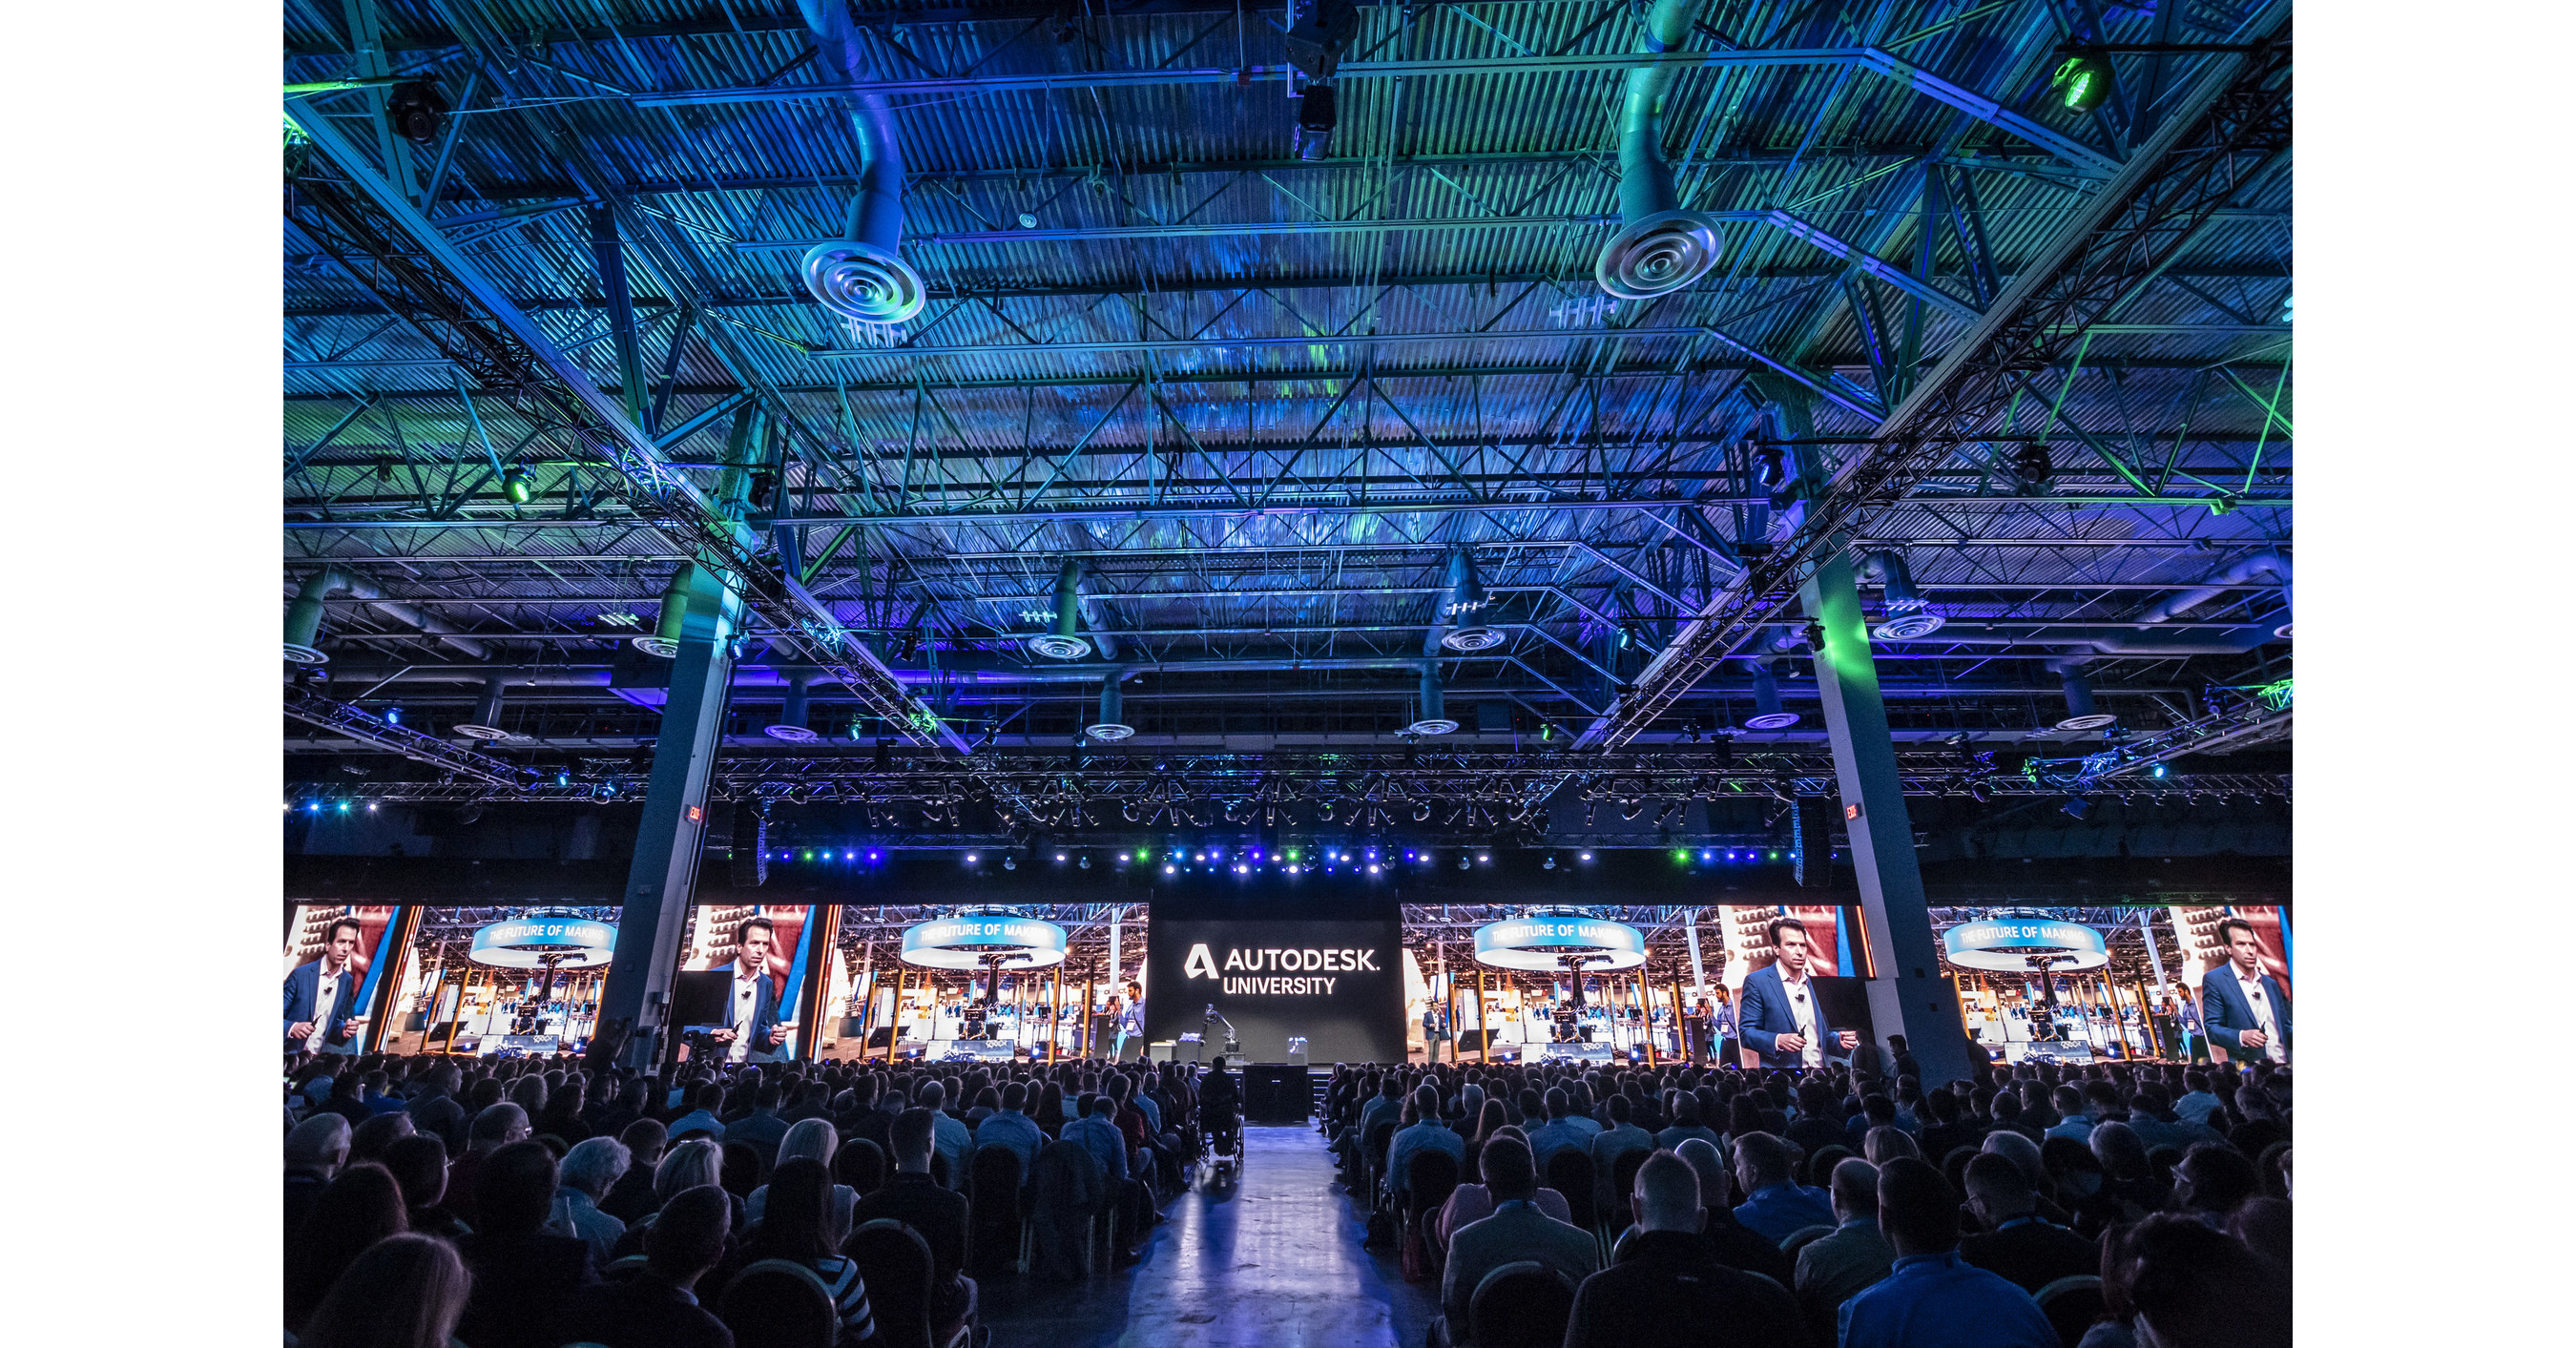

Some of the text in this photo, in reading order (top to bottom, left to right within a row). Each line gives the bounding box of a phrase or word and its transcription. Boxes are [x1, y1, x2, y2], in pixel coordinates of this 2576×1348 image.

[505, 924, 545, 939] FUTURE
[547, 924, 564, 937] OF
[565, 925, 605, 941] MAKING
[937, 923, 982, 939] FUTURE
[984, 923, 1002, 936] OF
[1004, 924, 1049, 939] MAK
[1509, 924, 1555, 939] FUTURE
[1557, 924, 1575, 937] OF
[1578, 925, 1625, 941] MAK
[1977, 926, 2020, 942] FUTURE
[2022, 926, 2038, 938] OF
[2042, 927, 2087, 943] MAKING
[1224, 948, 1381, 971] AUTODESK.
[1223, 977, 1336, 995] UNIVERSITY
